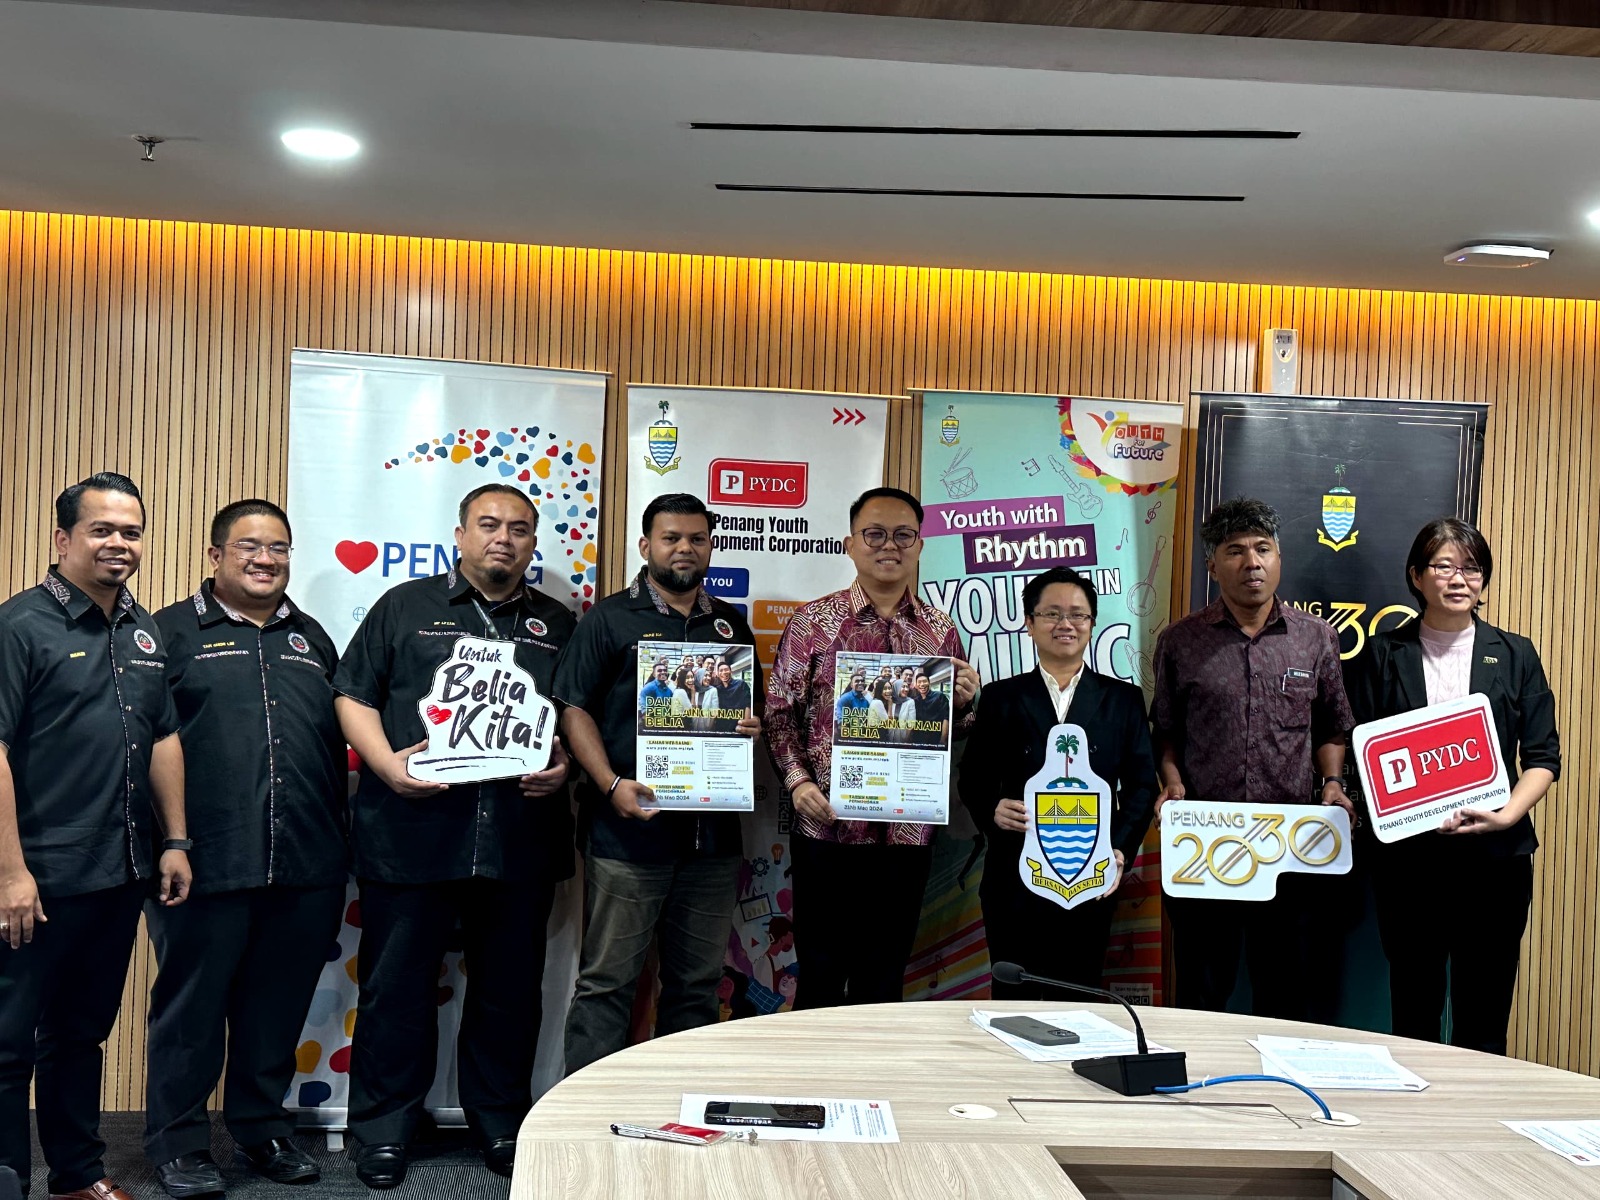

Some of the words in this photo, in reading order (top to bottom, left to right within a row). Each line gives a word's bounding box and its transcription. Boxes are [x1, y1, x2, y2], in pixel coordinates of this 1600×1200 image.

[1113, 443, 1164, 461] Future
[748, 477, 796, 492] PYDC
[713, 513, 764, 534] Penang
[769, 517, 808, 534] Youth
[940, 505, 1005, 530] Youth
[1010, 503, 1058, 526] with
[973, 530, 1087, 568] Rhythm
[382, 542, 544, 585] PENG
[711, 578, 733, 587] YOU
[1096, 568, 1122, 595] IN
[458, 645, 502, 662] Untuk
[438, 663, 527, 705] Belia
[449, 703, 549, 751] Kita!
[646, 717, 684, 728] BELIA
[841, 728, 880, 739] BELIA
[1417, 738, 1480, 776] PYDC
[1171, 811, 1245, 827] PENANG
[1379, 818, 1404, 831] PENANG
[1403, 813, 1424, 823] YOUTH
[1424, 799, 1465, 818] DEVELOPMENT
[1466, 787, 1507, 805] CORPORATION
[1172, 813, 1341, 885] 2030
